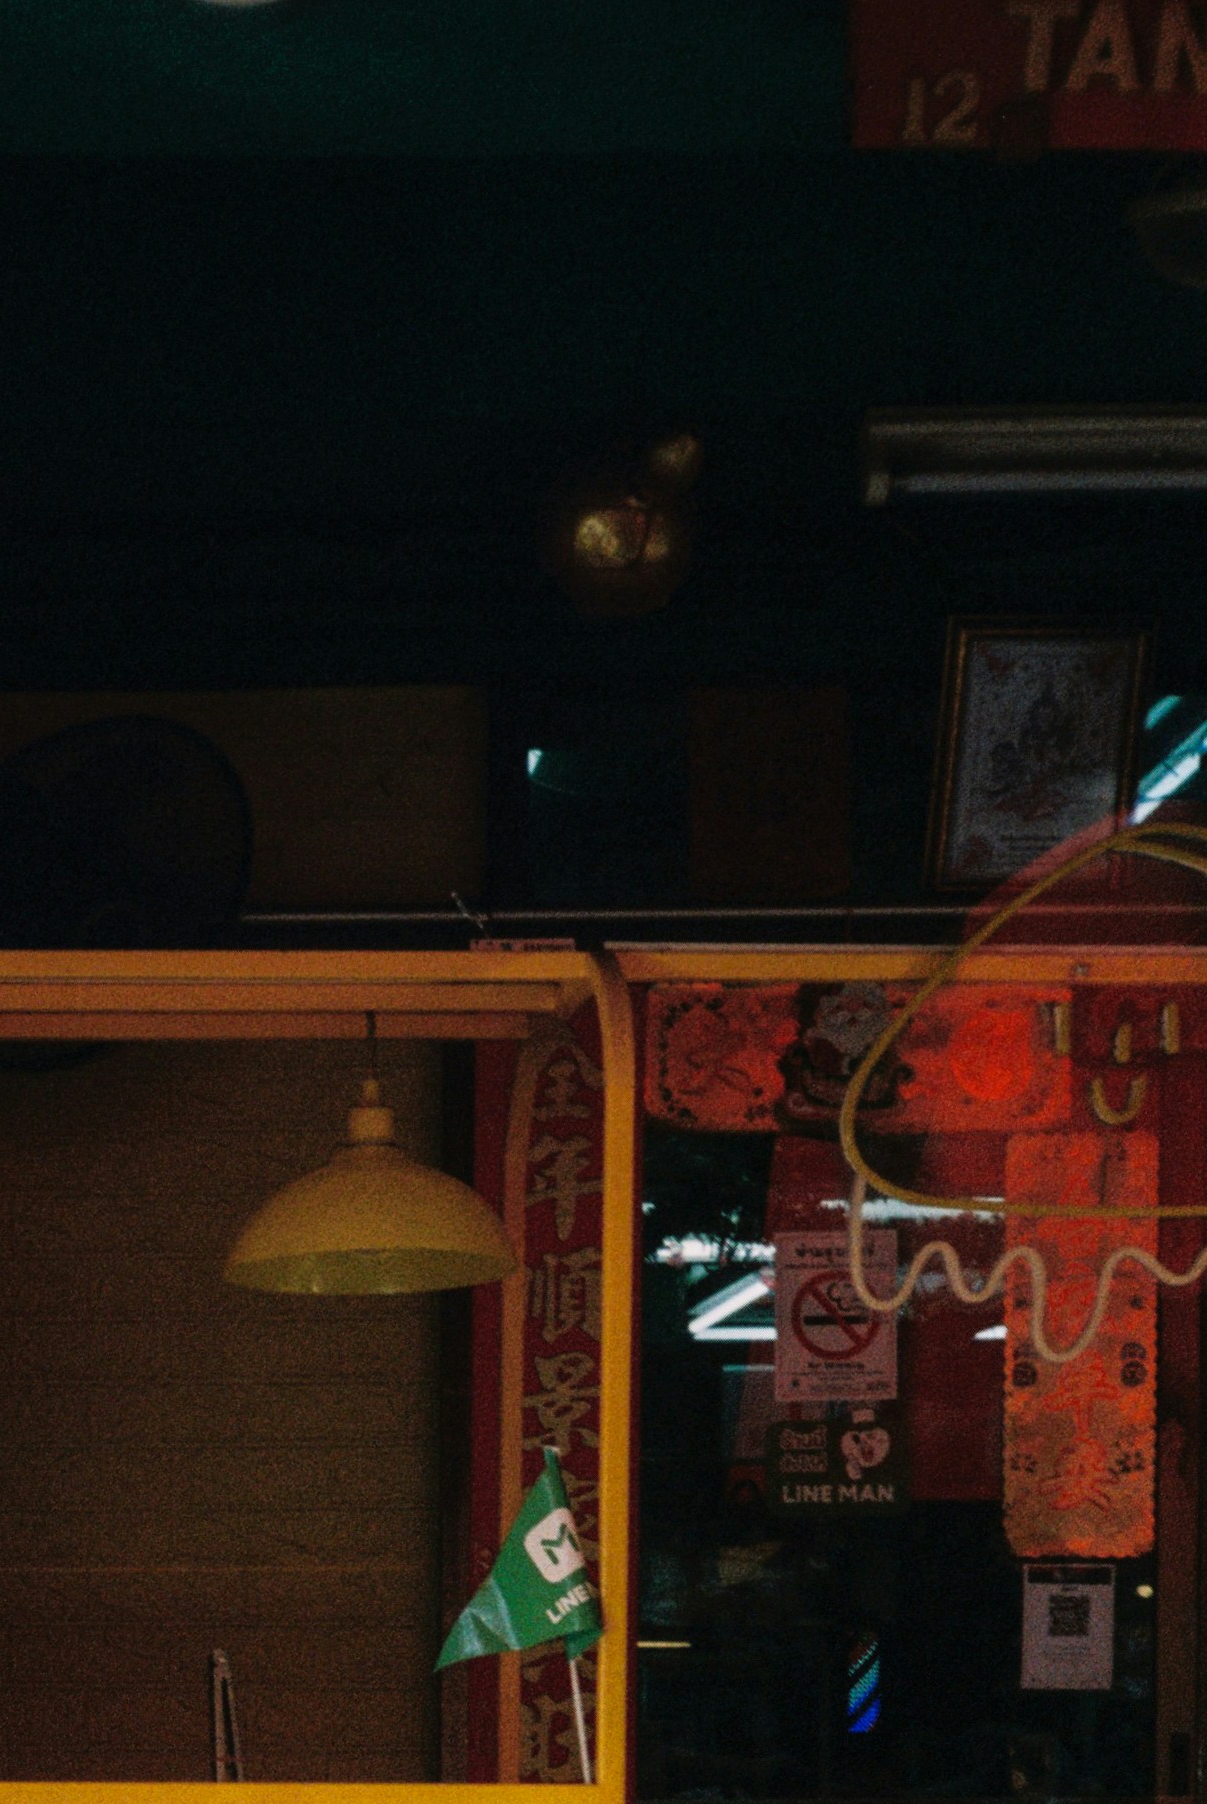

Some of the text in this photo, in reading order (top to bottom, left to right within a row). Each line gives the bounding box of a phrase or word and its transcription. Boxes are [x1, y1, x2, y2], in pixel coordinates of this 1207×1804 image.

[782, 1483, 895, 1504] LINE MAN
[545, 1583, 589, 1624] LINE
